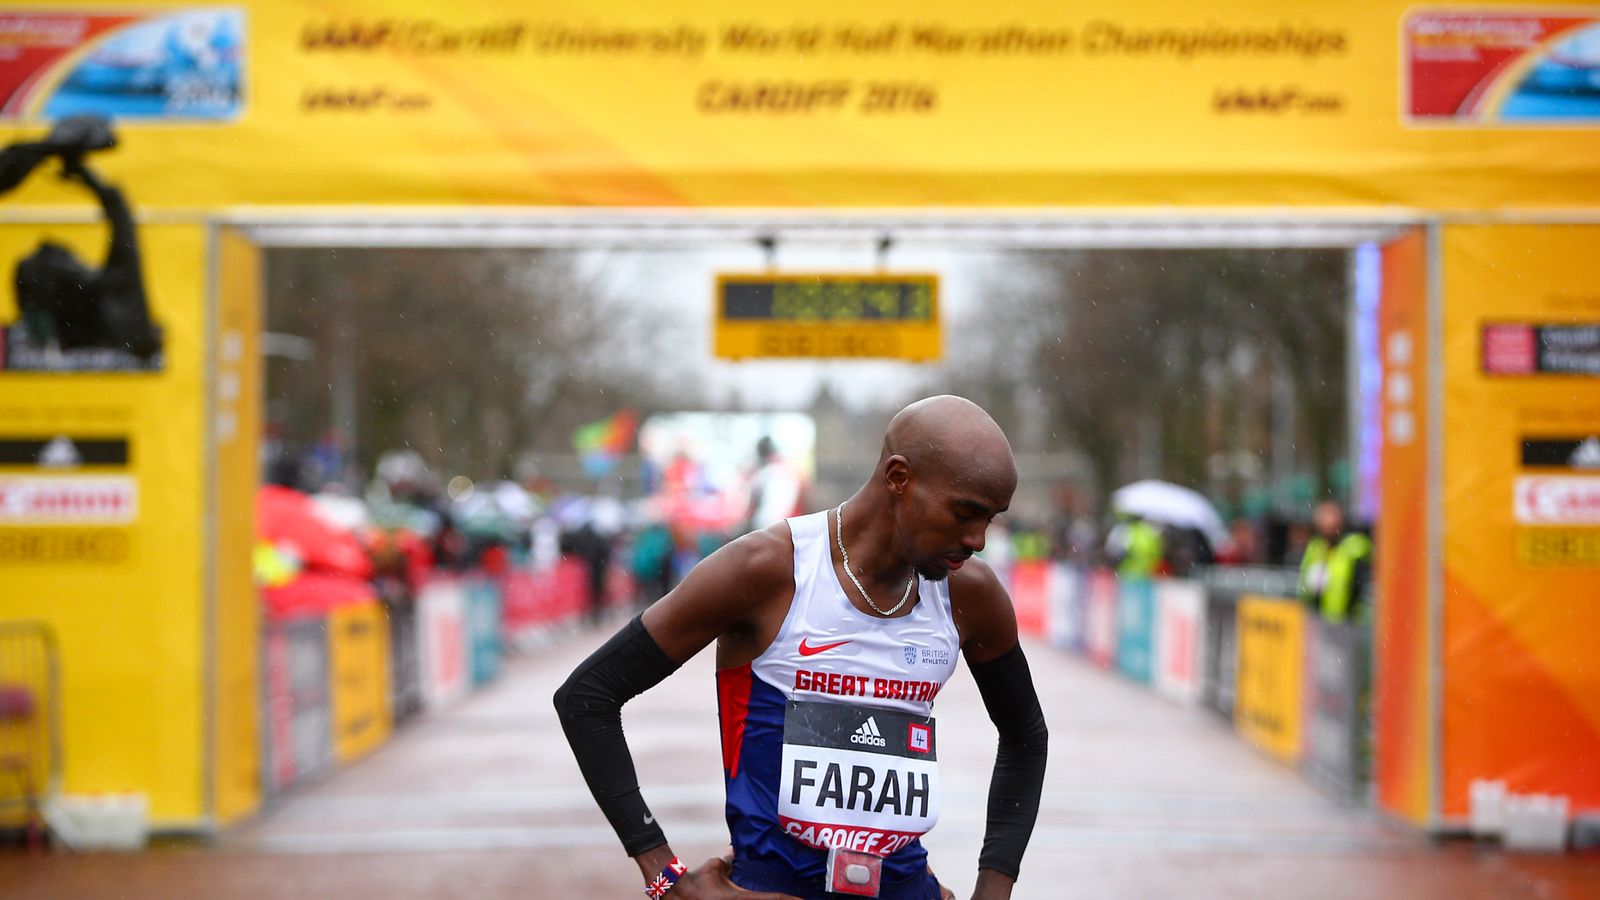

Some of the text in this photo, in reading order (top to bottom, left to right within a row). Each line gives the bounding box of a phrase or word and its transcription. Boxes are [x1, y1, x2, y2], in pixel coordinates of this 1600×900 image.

[795, 669, 869, 697] GREAT
[850, 734, 886, 747] adidas
[914, 733, 926, 747] 4
[790, 758, 930, 818] FARAH
[786, 821, 884, 853] CARDIFF
